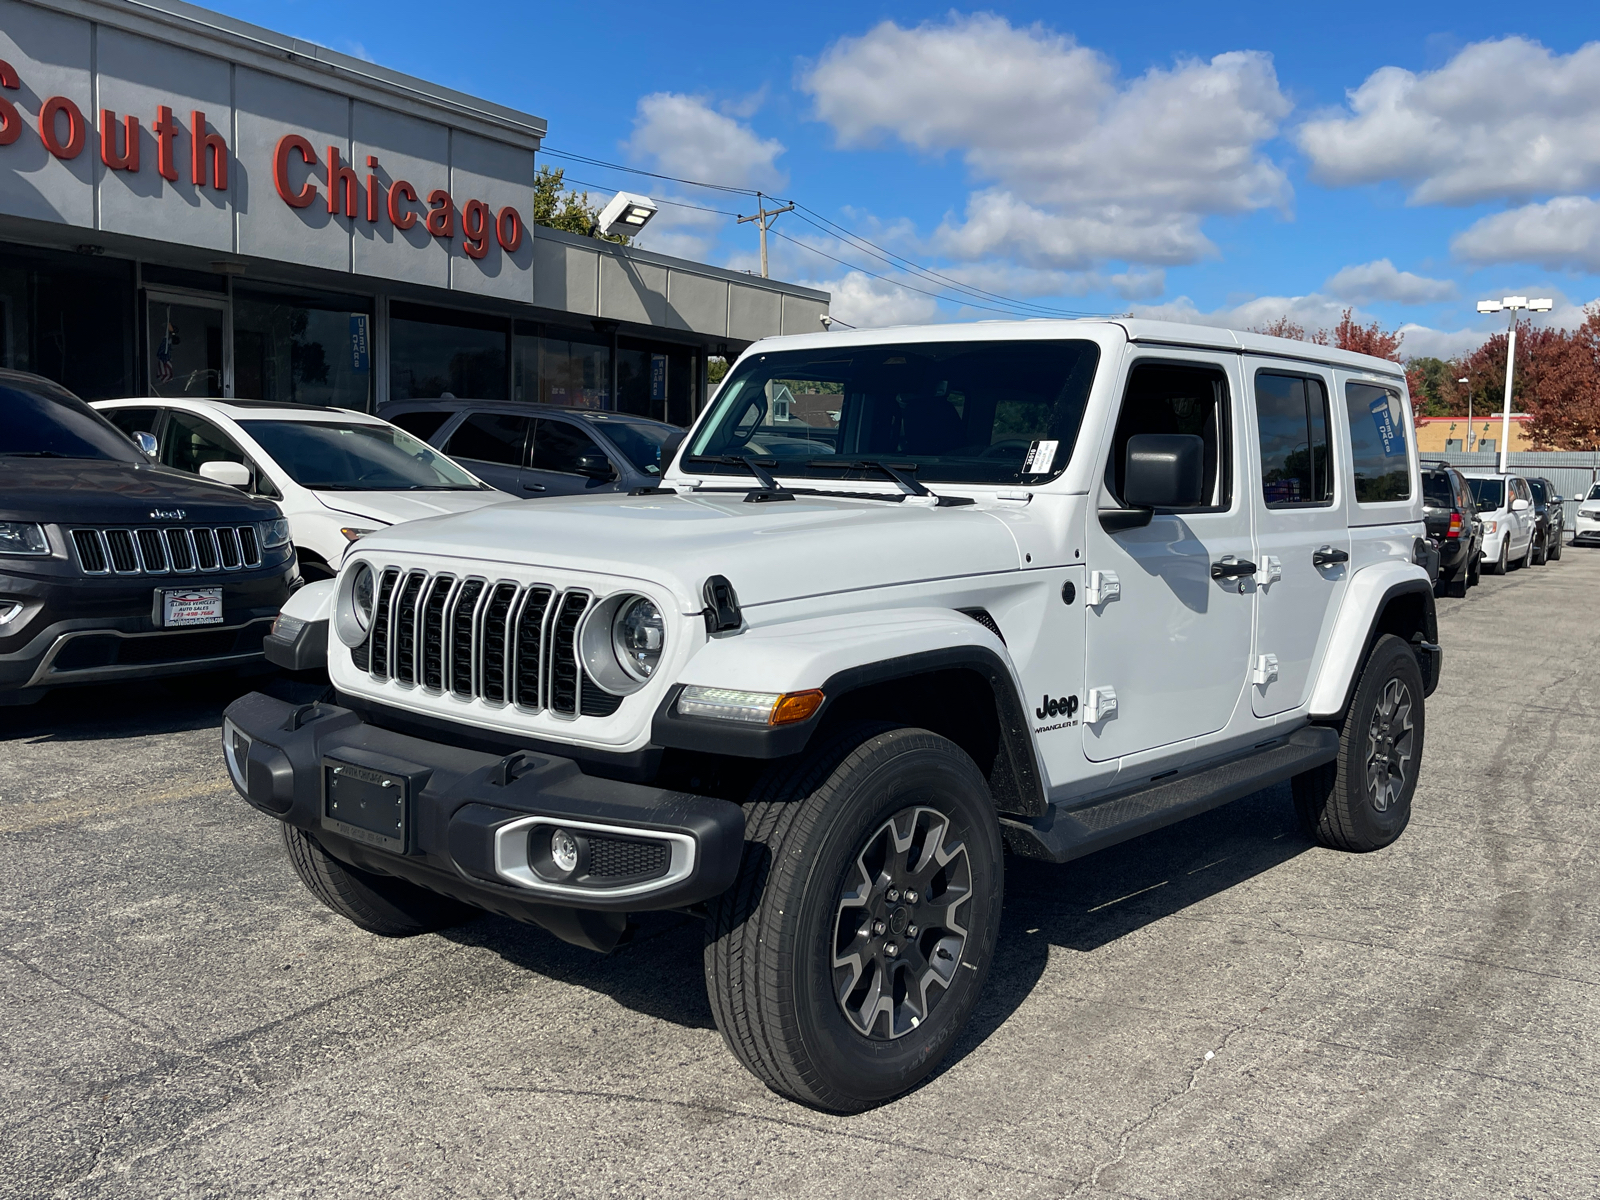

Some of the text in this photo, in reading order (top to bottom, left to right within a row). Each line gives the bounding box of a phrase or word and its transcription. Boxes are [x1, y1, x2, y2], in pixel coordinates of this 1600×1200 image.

[273, 134, 523, 260] Chicago
[150, 508, 187, 520] Jeep
[1036, 694, 1079, 719] Jeep
[1034, 721, 1072, 733] WRANGLER
